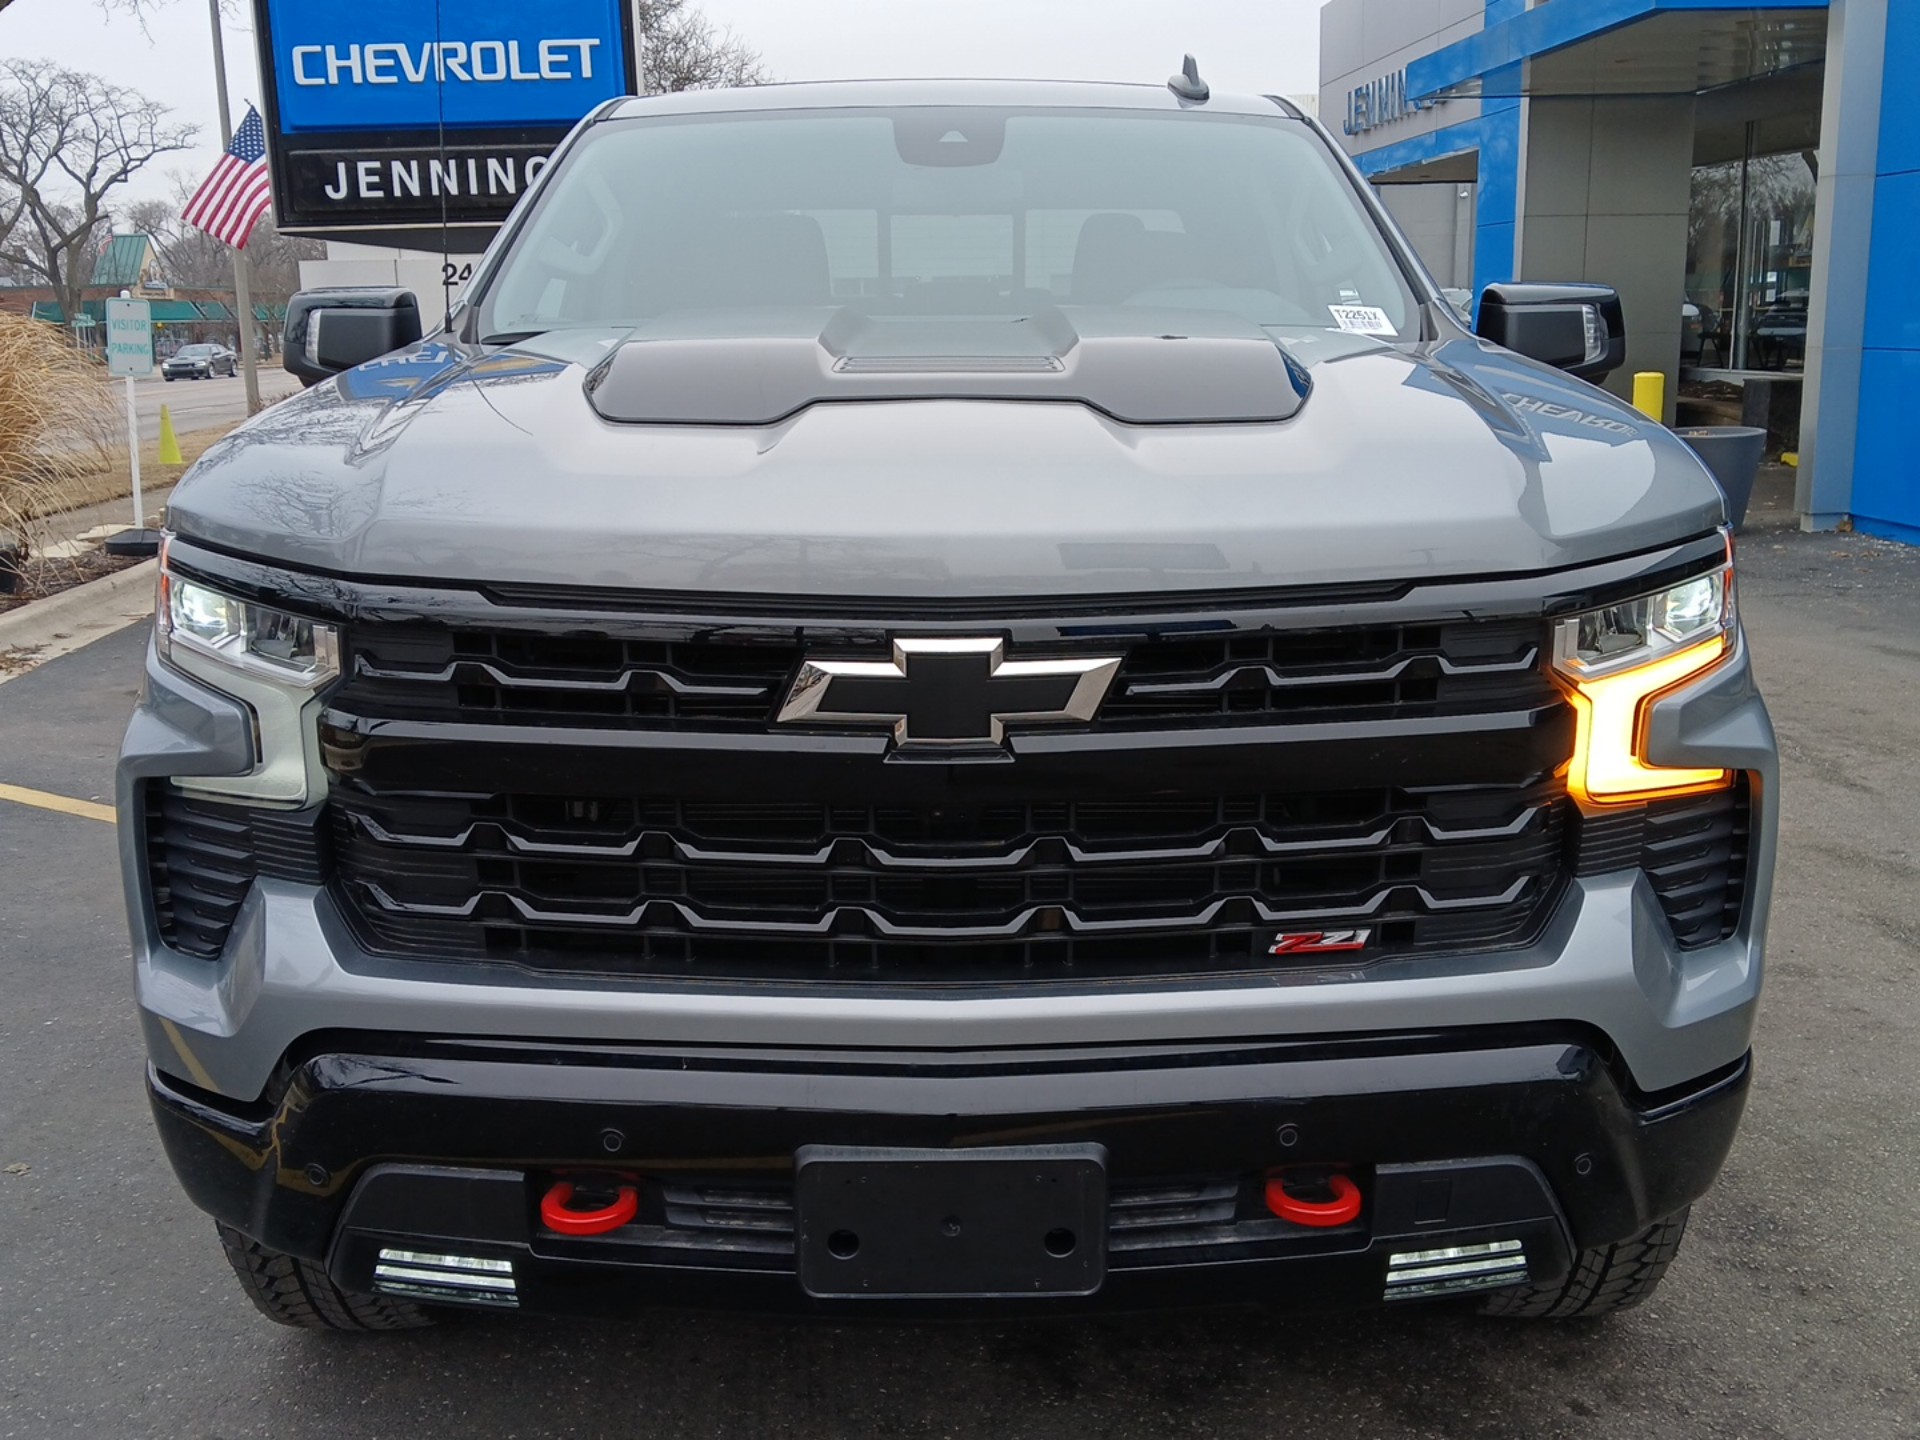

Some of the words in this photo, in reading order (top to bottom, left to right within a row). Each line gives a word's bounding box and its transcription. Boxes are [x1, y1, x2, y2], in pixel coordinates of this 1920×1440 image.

[292, 38, 600, 85] CHEVROLET
[111, 319, 146, 332] VISITOR
[111, 342, 149, 355] PARKING
[1268, 929, 1372, 955] Z71
